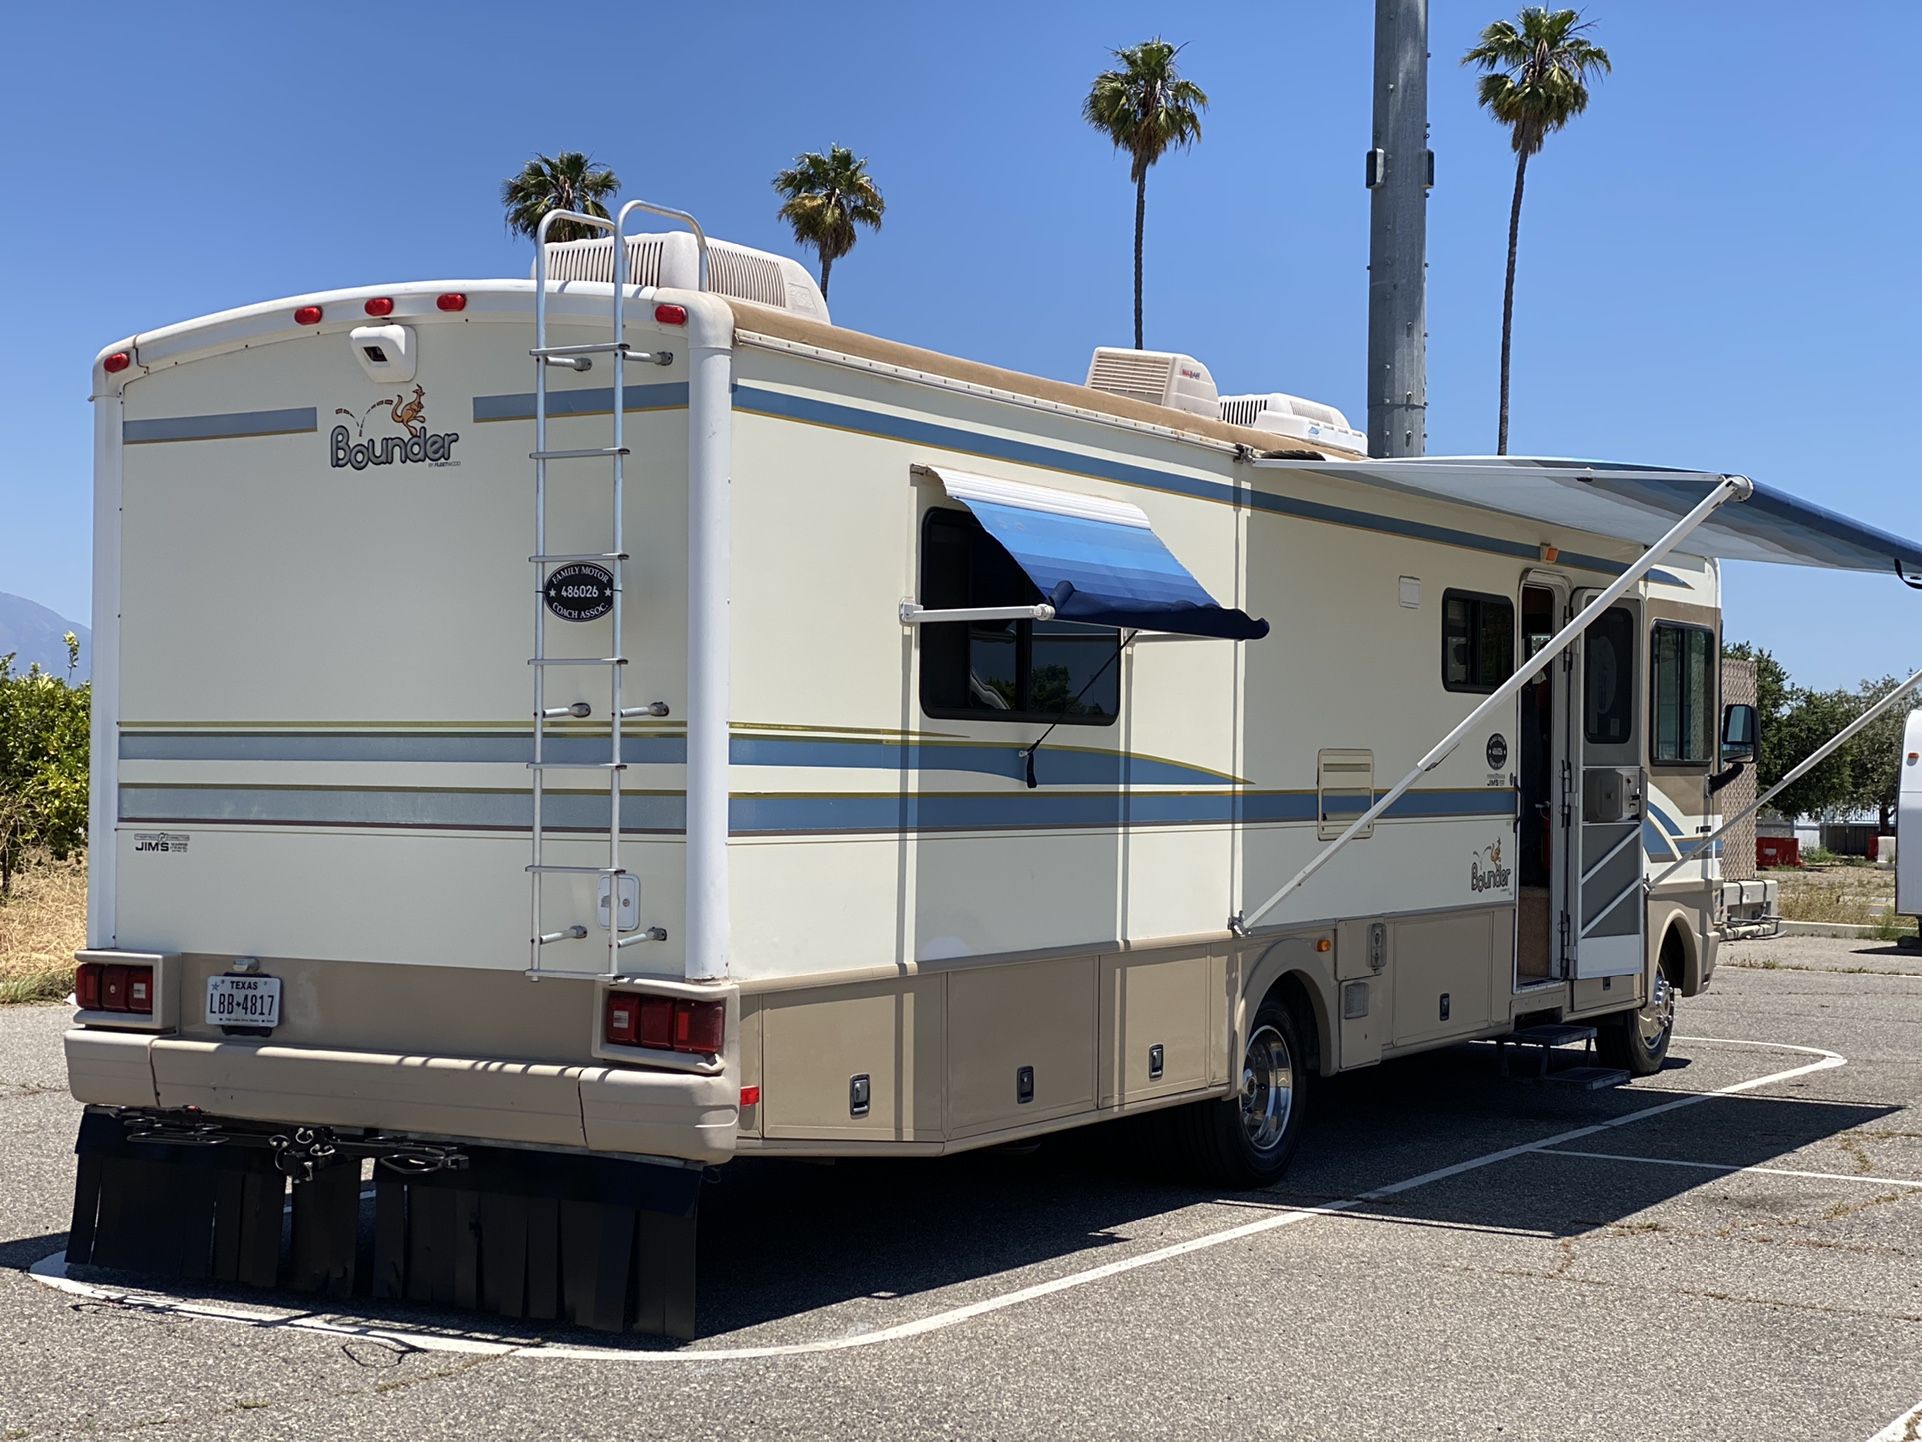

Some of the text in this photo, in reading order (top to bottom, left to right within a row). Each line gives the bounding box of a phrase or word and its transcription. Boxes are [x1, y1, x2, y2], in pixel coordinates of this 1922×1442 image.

[330, 425, 459, 471] Bounder
[552, 566, 609, 584] FAMILY MOTOR
[561, 585, 599, 598] 486026
[552, 602, 609, 619] COACH ASSOC.
[1471, 862, 1511, 893] Bounder
[230, 981, 258, 990] TEXAS
